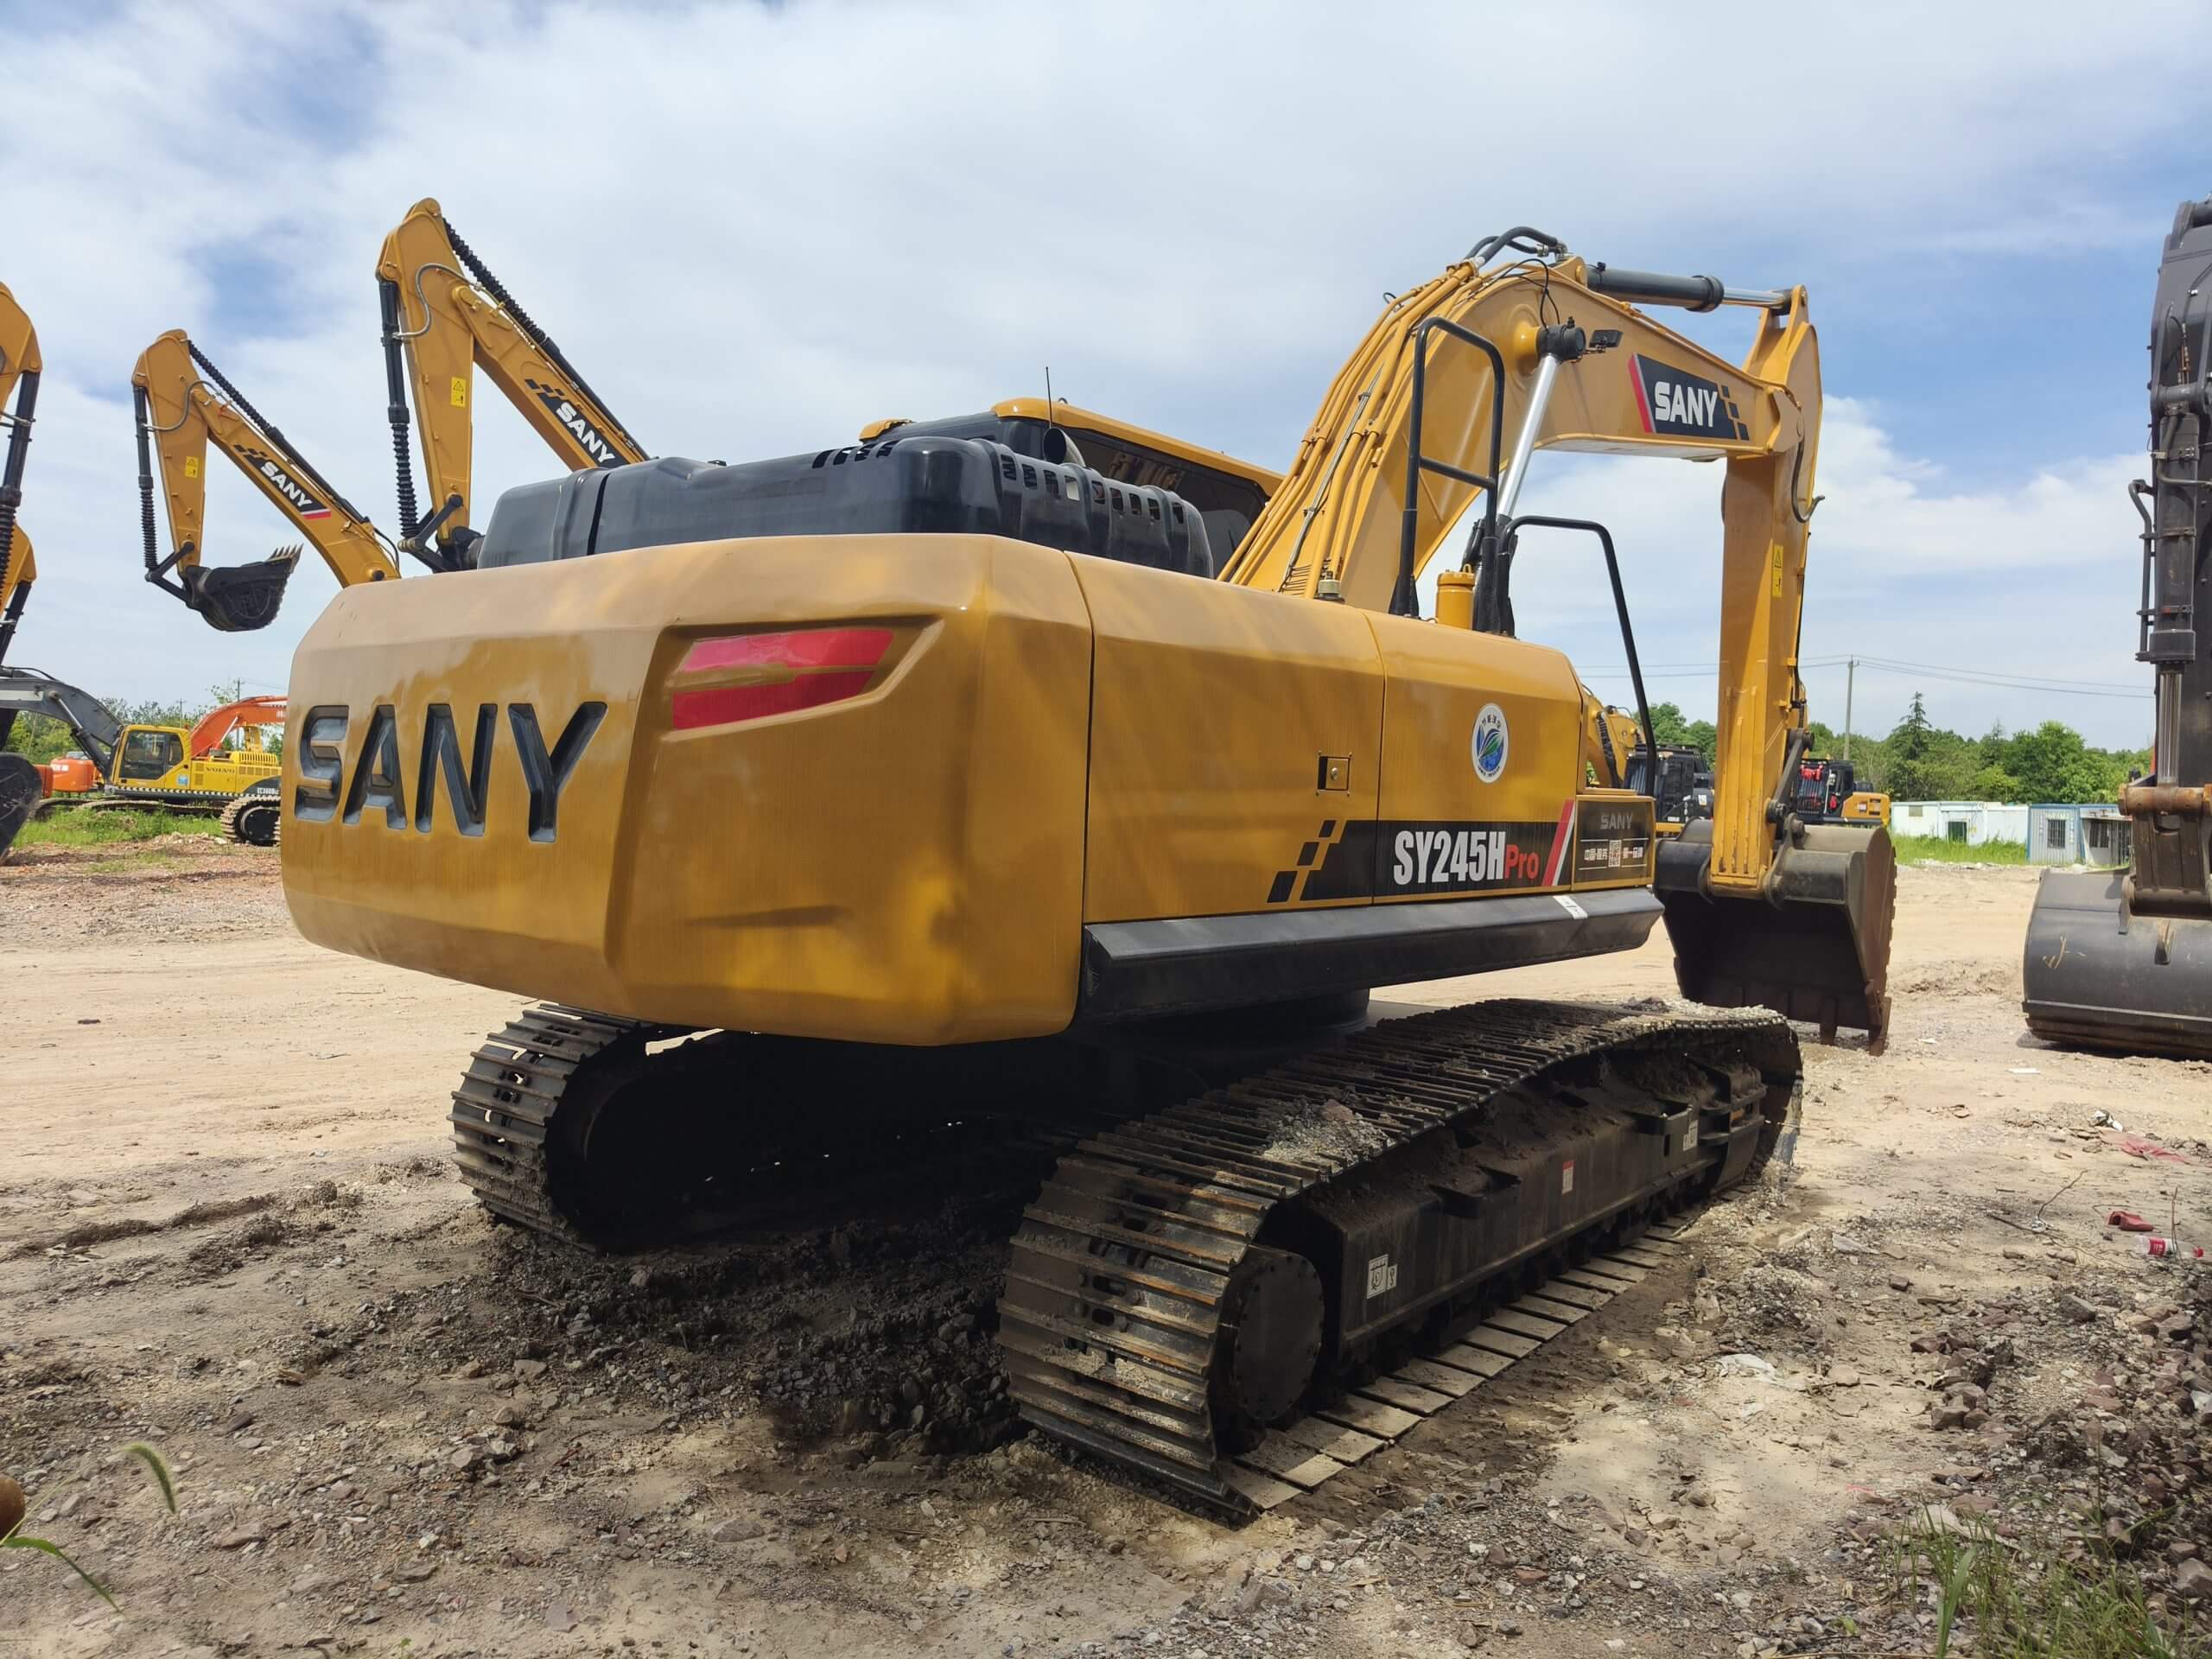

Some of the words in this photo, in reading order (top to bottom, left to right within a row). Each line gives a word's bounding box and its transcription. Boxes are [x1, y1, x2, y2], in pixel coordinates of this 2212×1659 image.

[1655, 381, 1718, 428] SANY
[556, 402, 615, 463] SANY
[261, 461, 313, 507] SANY
[207, 766, 235, 774] VOLVO
[294, 701, 608, 842] SANY
[1600, 813, 1633, 830] SANY
[1393, 830, 1506, 886] SY245H
[1504, 843, 1540, 880] Pro
